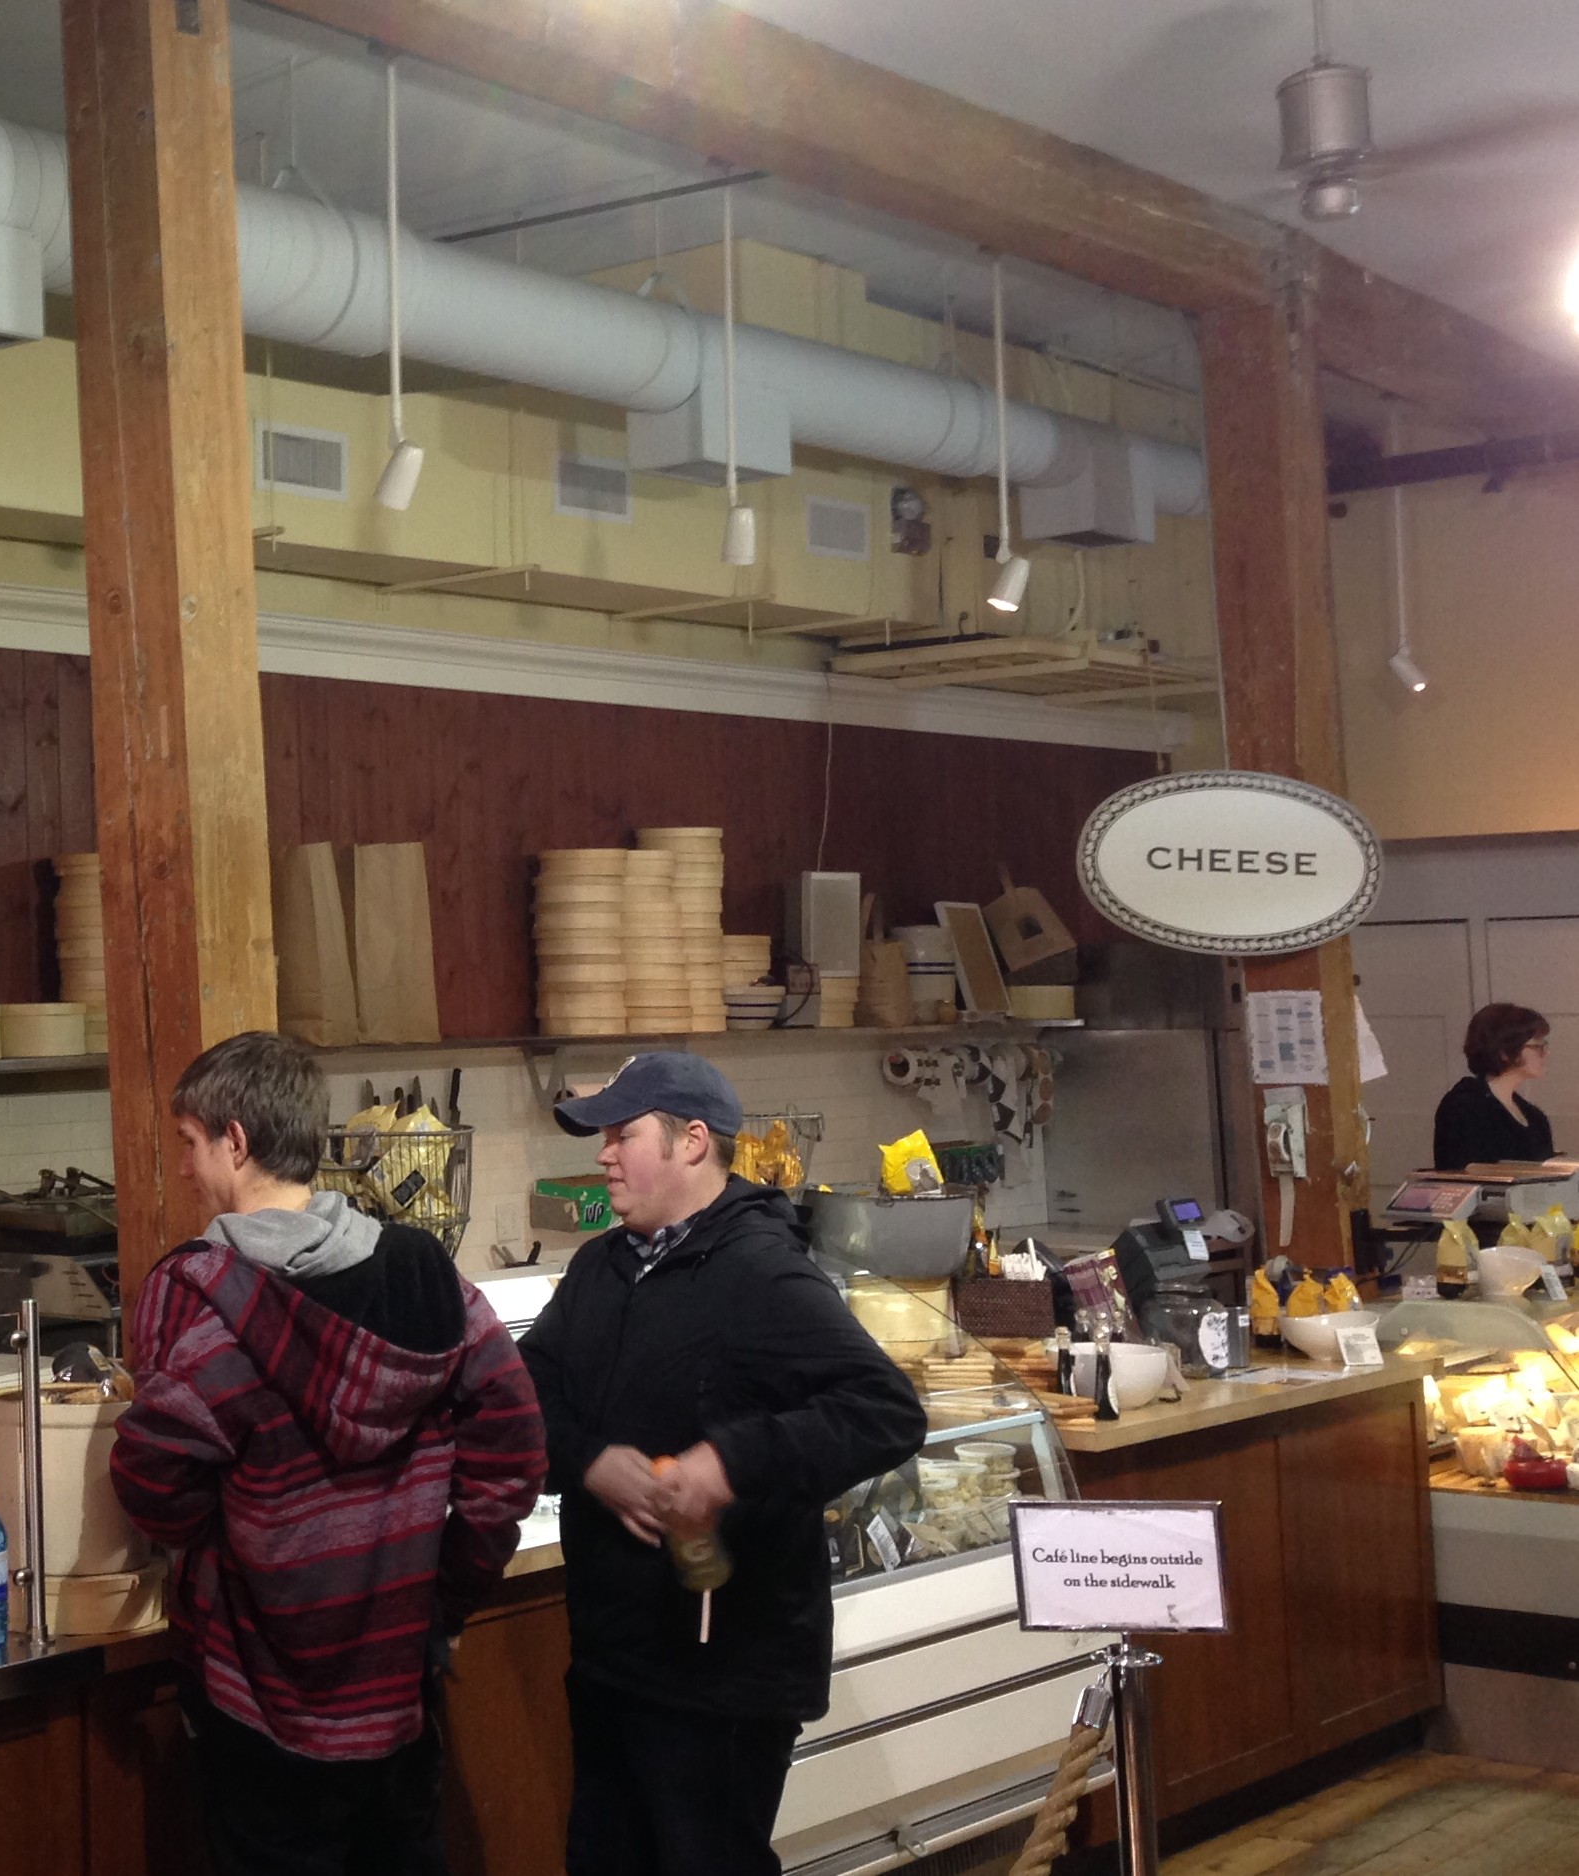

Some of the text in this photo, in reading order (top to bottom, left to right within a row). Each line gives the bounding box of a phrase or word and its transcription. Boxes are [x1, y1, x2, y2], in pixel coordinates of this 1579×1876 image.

[1146, 845, 1319, 877] CHEESE
[1032, 1547, 1203, 1567] Café line begins outside
[1063, 1573, 1176, 1589] on the sidewalk
